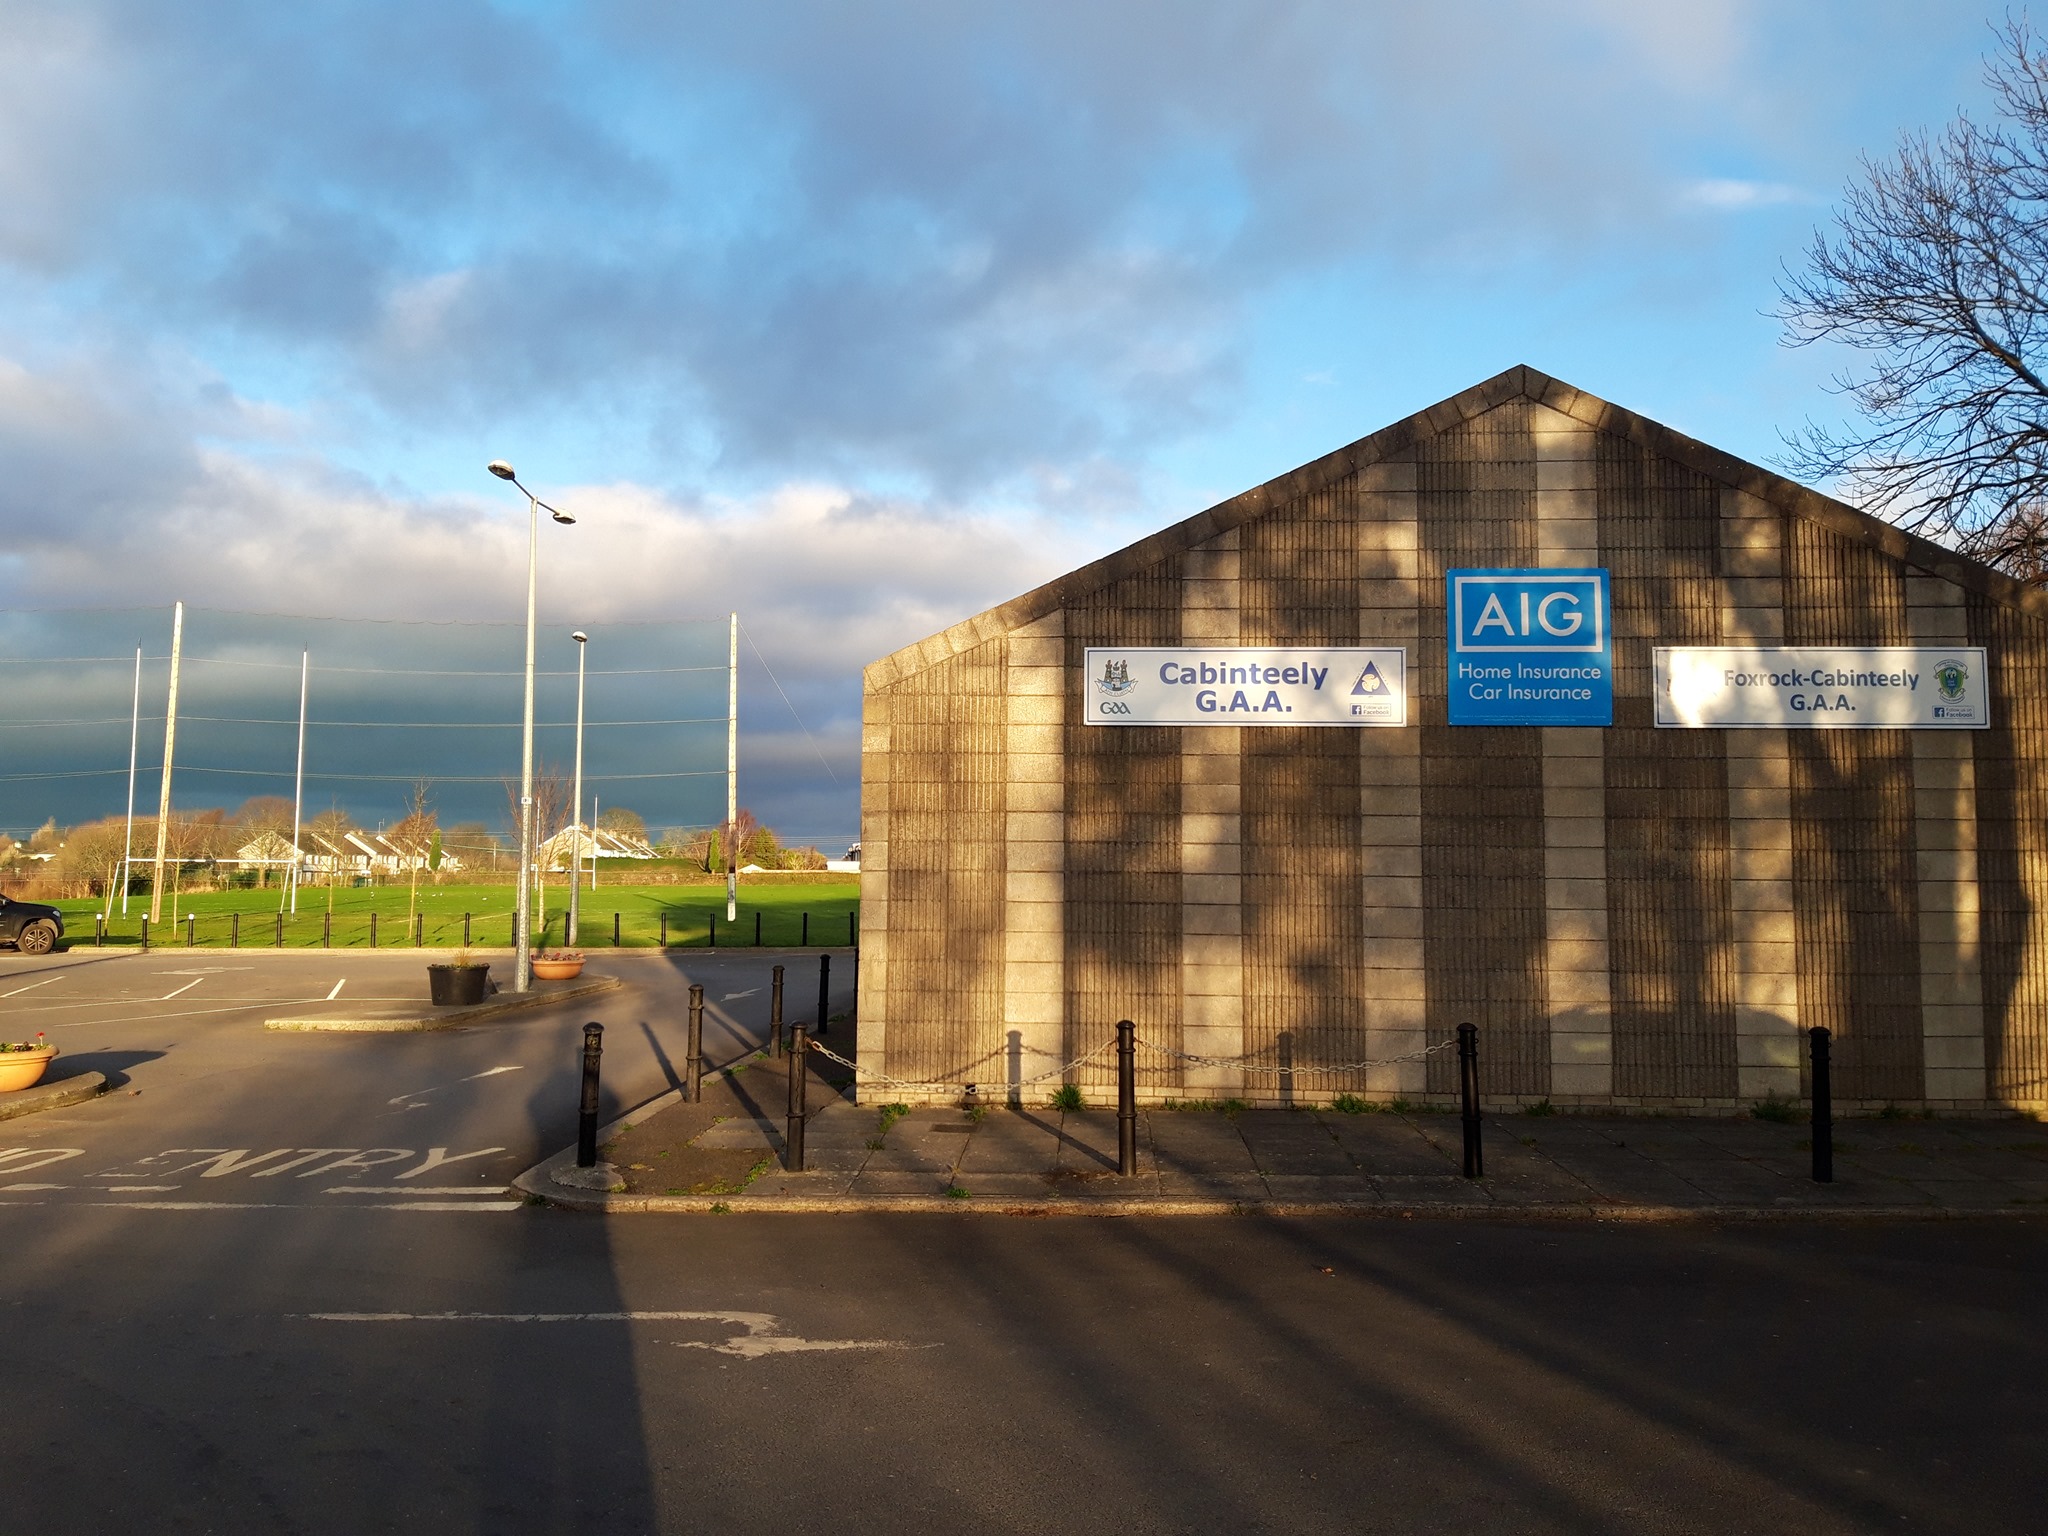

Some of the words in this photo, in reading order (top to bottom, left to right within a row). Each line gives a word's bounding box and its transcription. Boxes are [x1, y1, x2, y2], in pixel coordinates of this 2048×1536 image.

[1472, 591, 1583, 637] AIG
[1159, 661, 1329, 690] Cabinteely
[1458, 662, 1512, 680] Home
[1518, 662, 1602, 680] Insurance
[1724, 668, 1919, 691] Foxrock-Cabinteely
[1195, 690, 1292, 713] G.A.A.
[1469, 683, 1503, 700] Car
[1508, 683, 1592, 700] Insurance
[1789, 693, 1857, 712] G.A.A.
